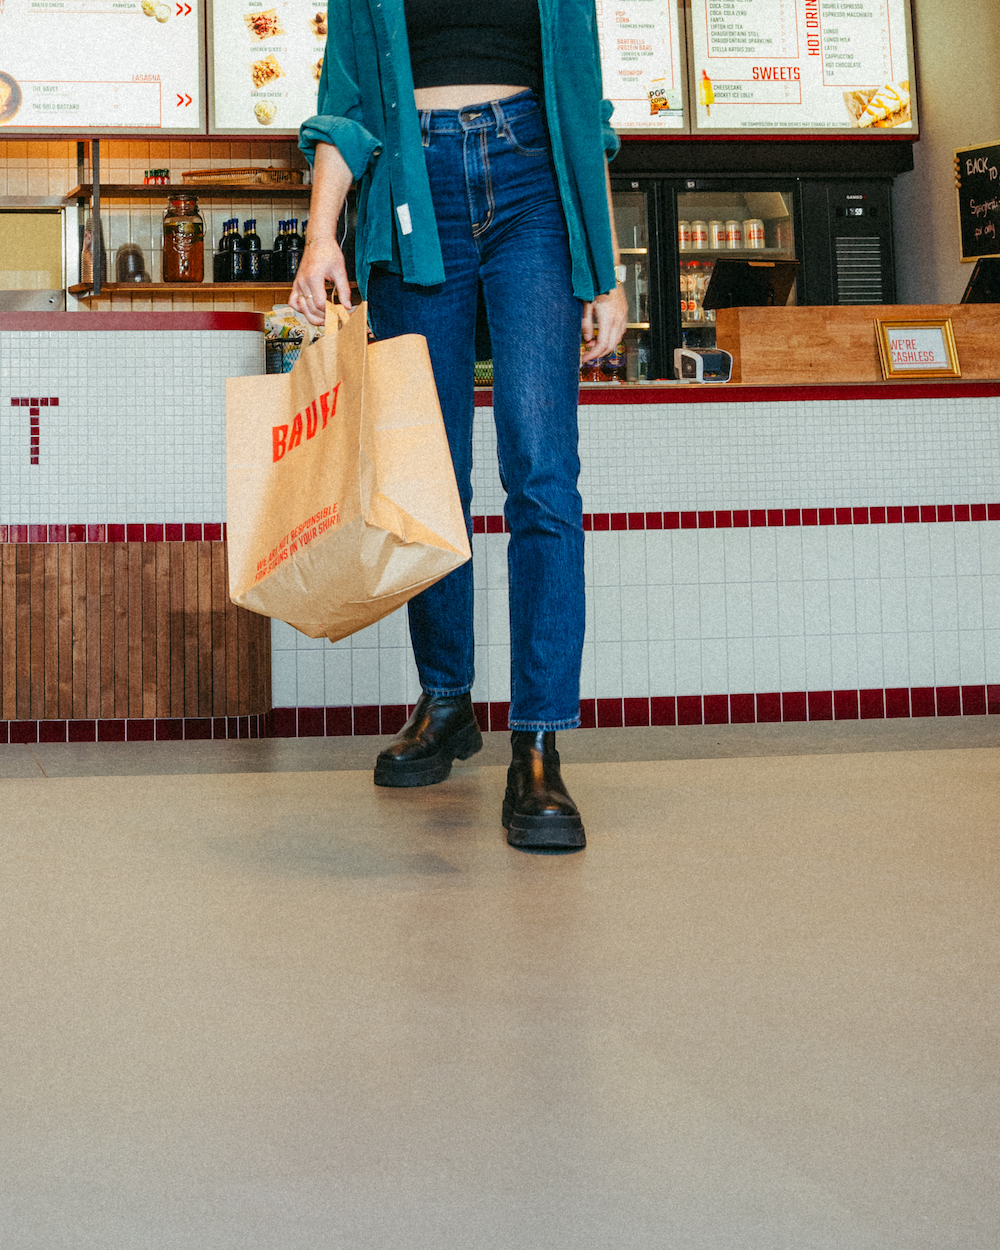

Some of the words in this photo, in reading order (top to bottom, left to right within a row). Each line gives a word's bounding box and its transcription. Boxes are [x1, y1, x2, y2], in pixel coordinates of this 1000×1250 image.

[0, 0, 6, 7] IT
[806, 32, 820, 56] HOT
[131, 74, 161, 82] LASAGNA
[752, 66, 801, 80] SWEETS
[966, 157, 988, 175] BACK
[890, 338, 917, 351] WE'RE
[891, 350, 935, 363] CASHLESS
[256, 556, 268, 572] WE
[290, 502, 338, 542] RESPONSIBLE
[298, 526, 318, 548] YOUR
